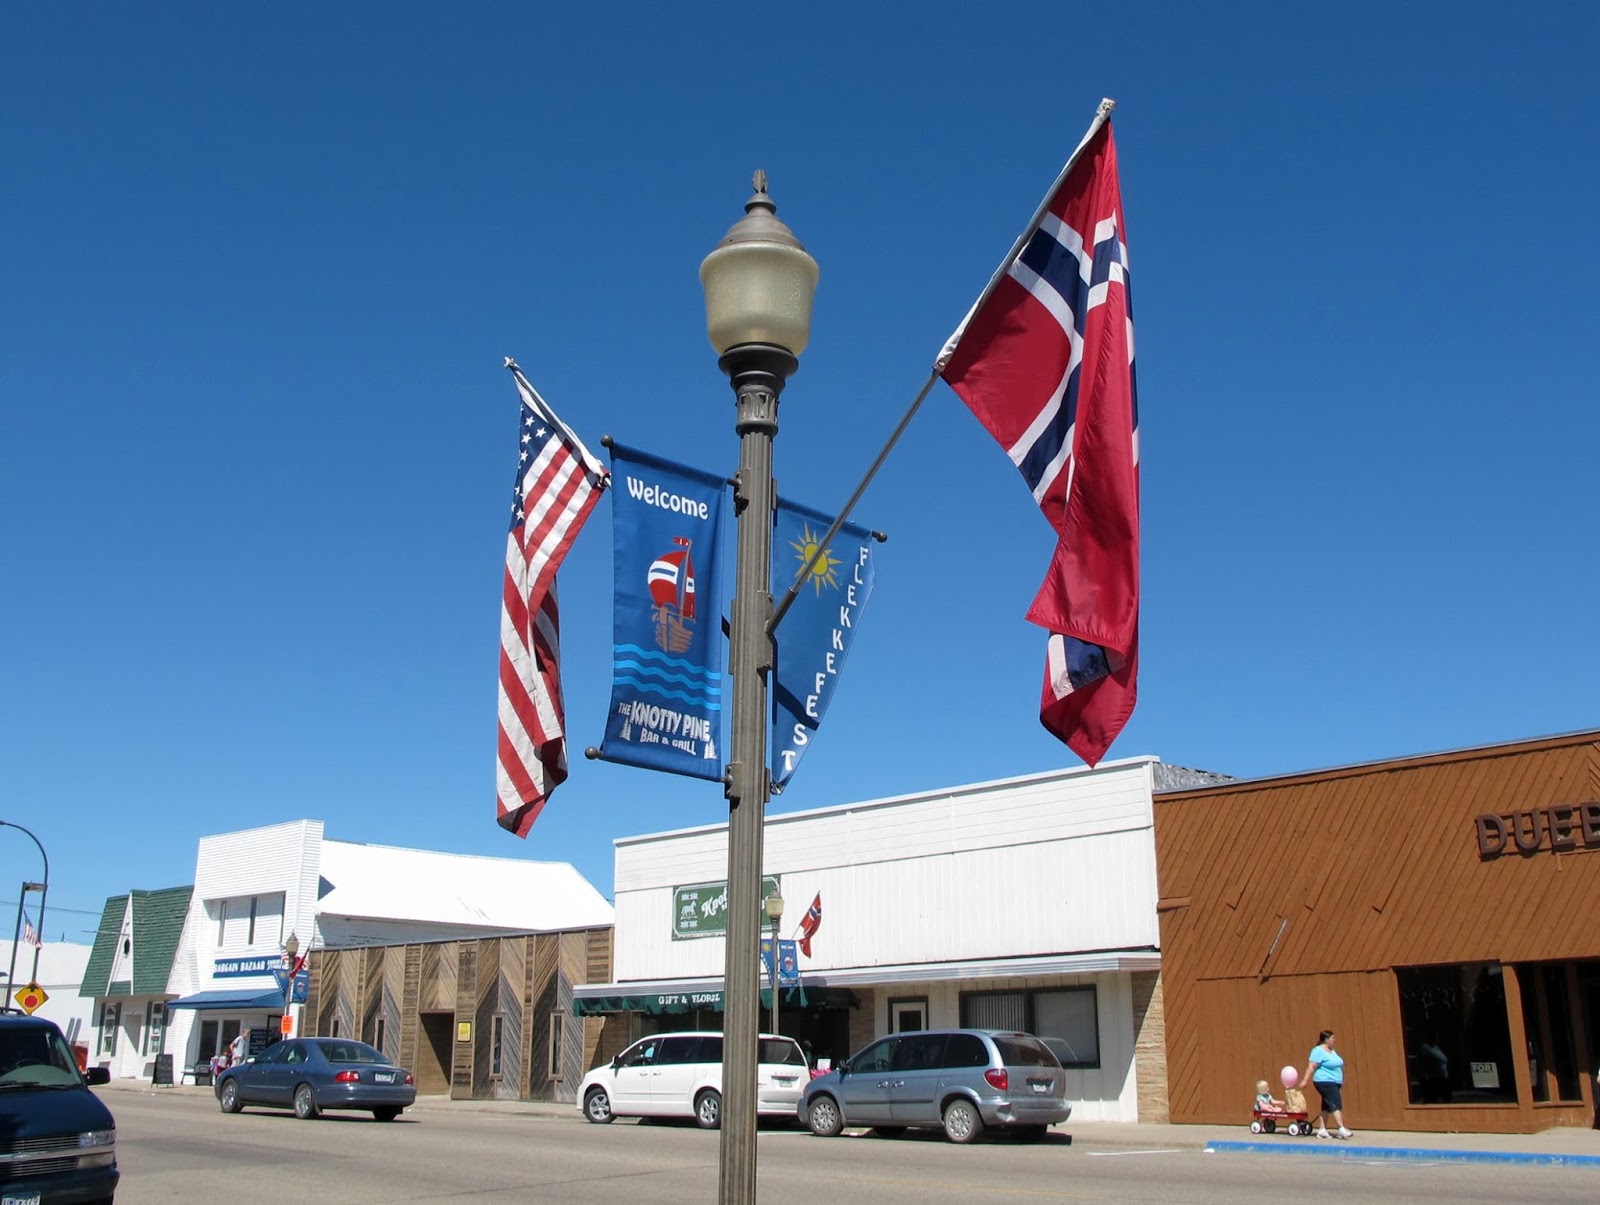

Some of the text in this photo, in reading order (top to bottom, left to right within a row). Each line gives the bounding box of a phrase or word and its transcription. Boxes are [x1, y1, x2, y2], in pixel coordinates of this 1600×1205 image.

[626, 475, 709, 520] Welcome
[781, 546, 869, 772] FLEKKEFEST
[618, 701, 711, 742] THE KNOTTY PINE
[640, 727, 697, 756] BAR & GRILL
[658, 995, 679, 1005] GIFT
